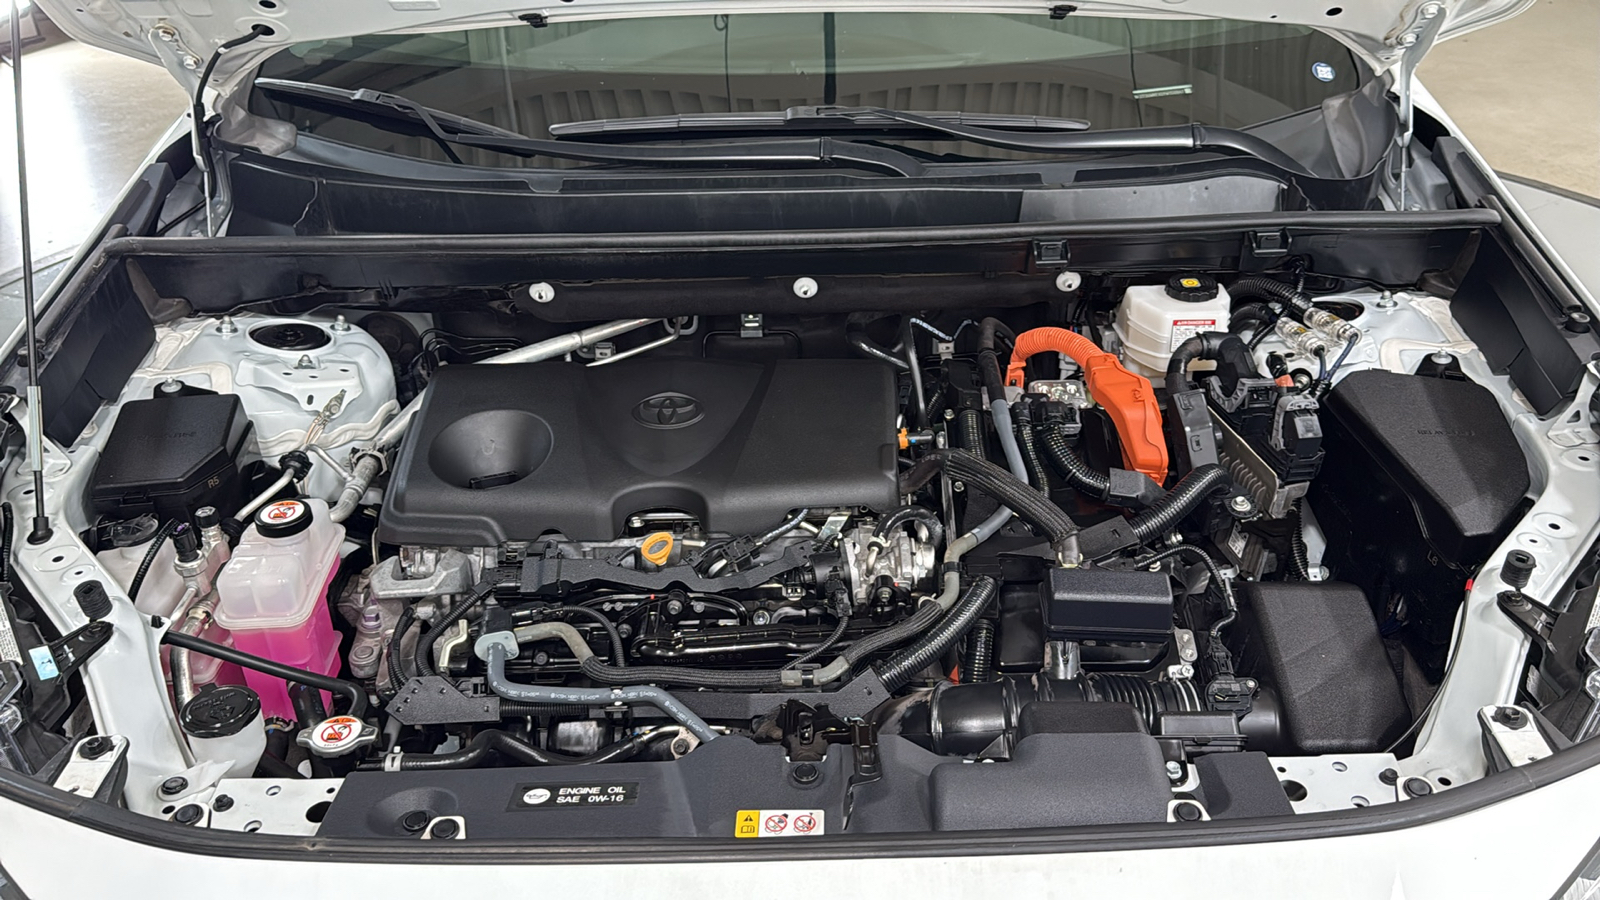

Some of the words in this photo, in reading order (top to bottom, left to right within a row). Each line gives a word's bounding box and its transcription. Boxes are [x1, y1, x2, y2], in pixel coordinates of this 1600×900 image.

[208, 476, 220, 489] R5
[559, 787, 601, 795] ENGINE
[608, 786, 626, 794] OIL
[588, 795, 624, 803] 0W-16
